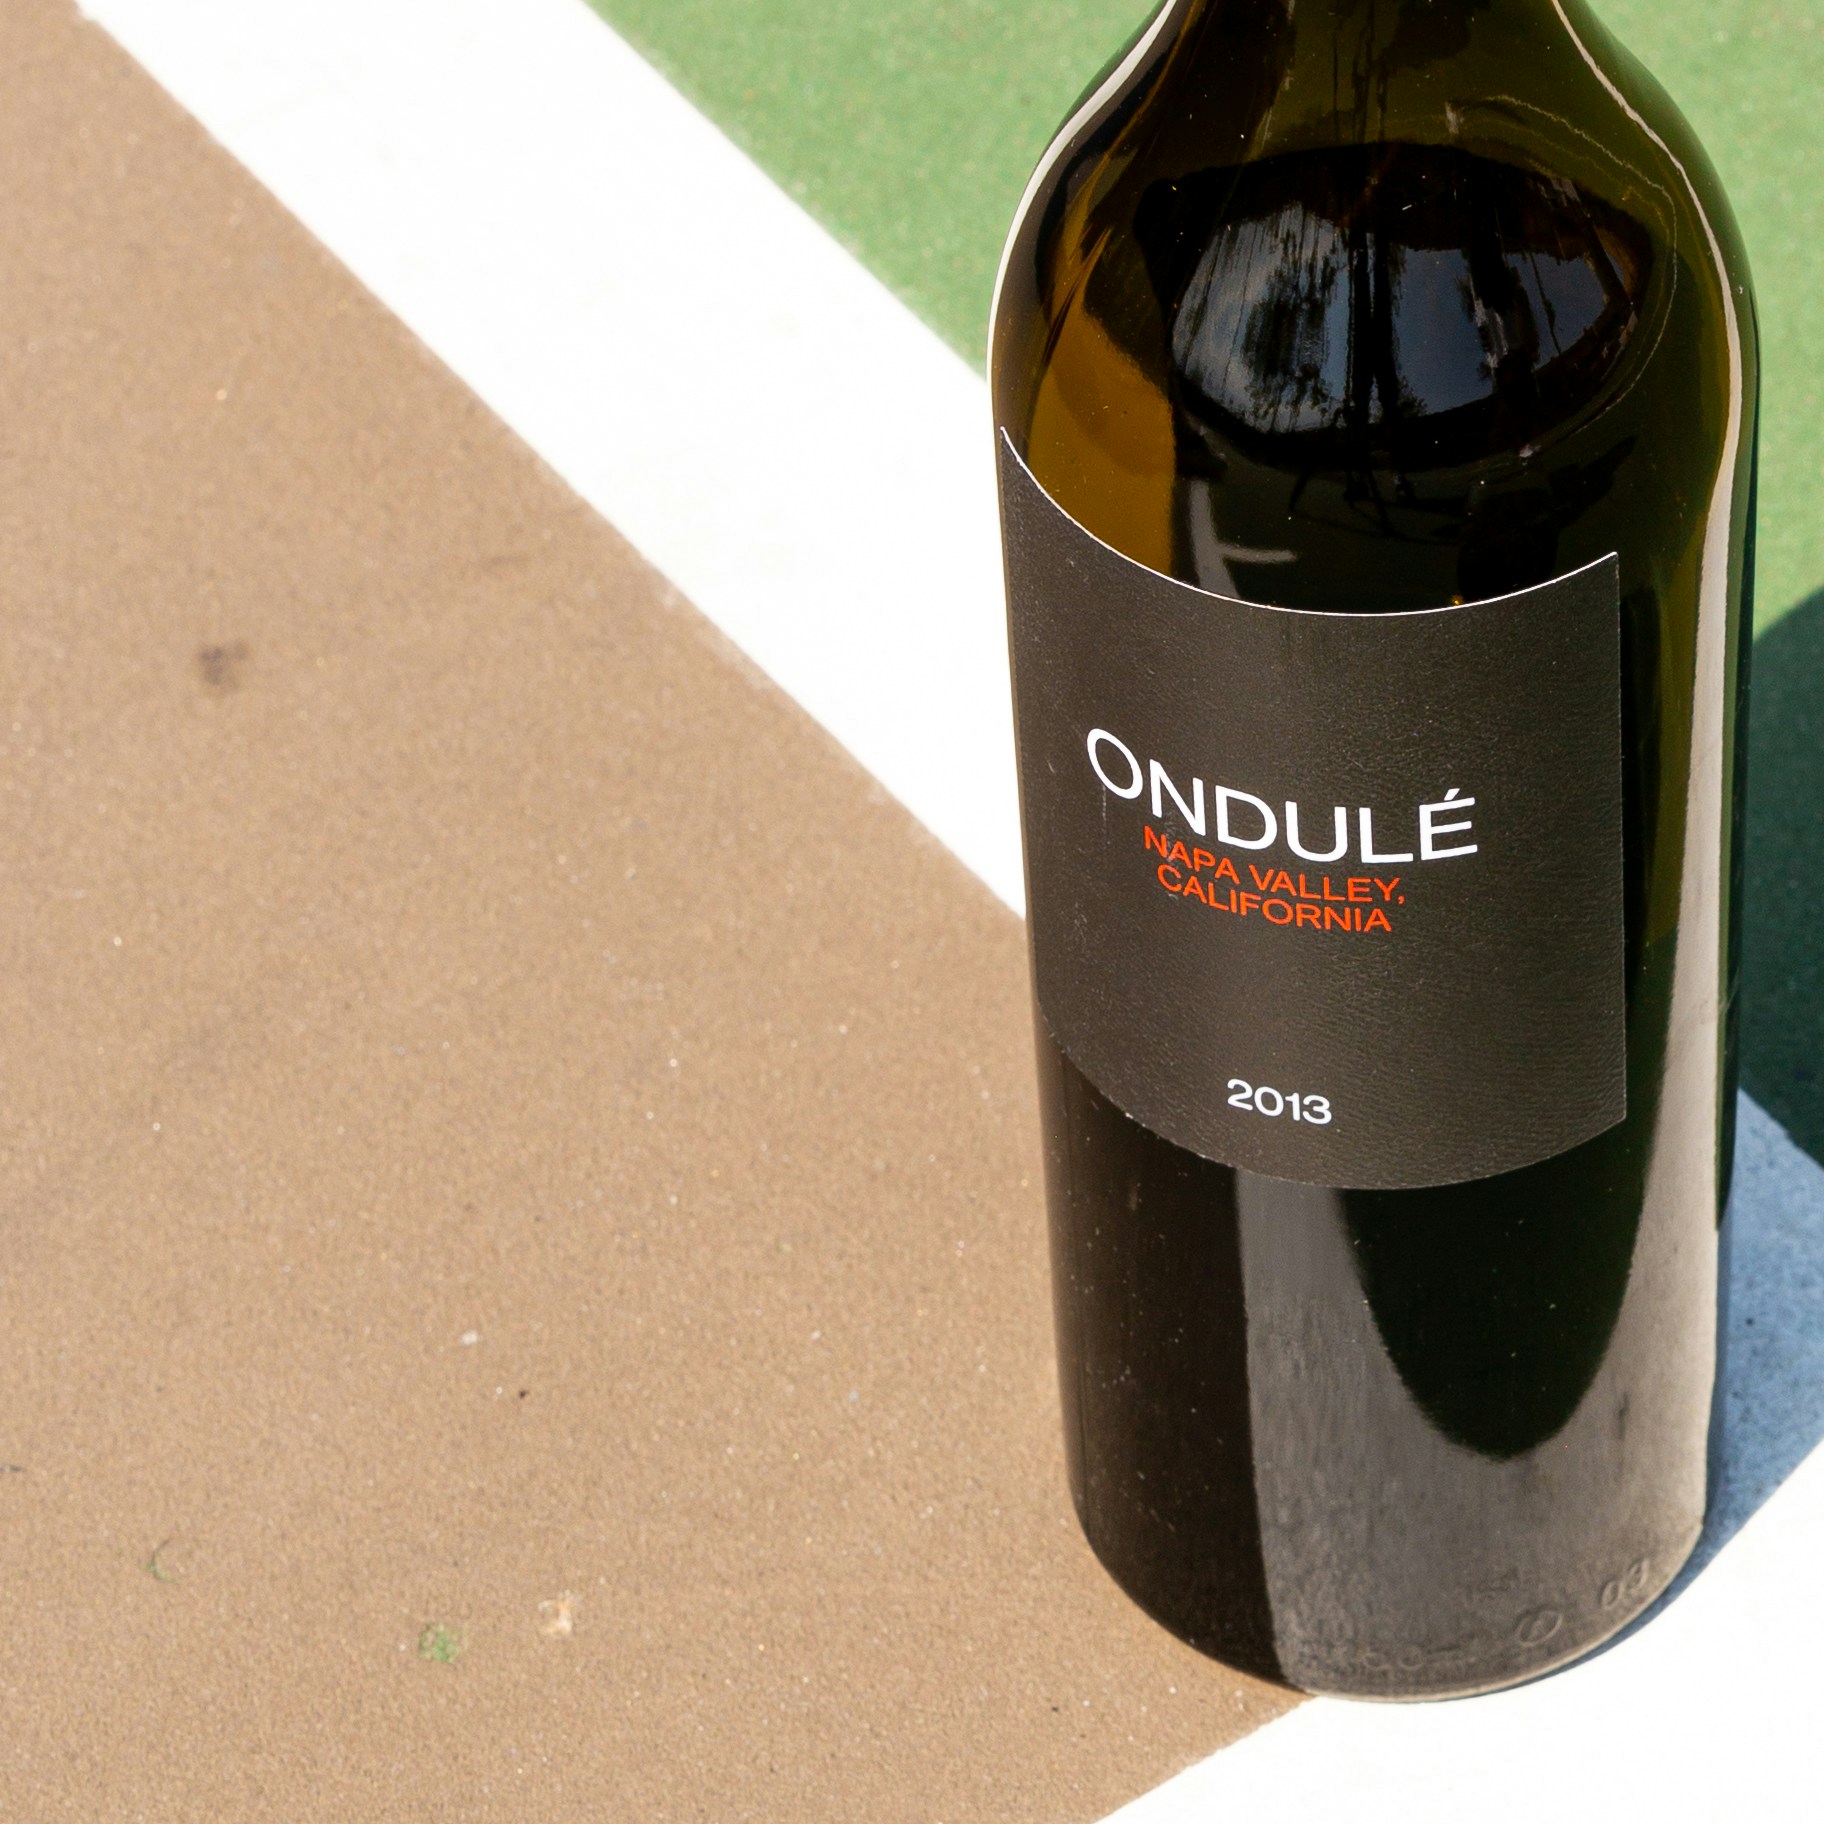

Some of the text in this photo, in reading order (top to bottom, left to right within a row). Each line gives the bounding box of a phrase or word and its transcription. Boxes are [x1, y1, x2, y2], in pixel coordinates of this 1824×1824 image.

[1086, 728, 1478, 864] ONDULÉ
[1143, 824, 1405, 905] NAPA VALLEY,
[1156, 863, 1393, 933] CALIFORNIA
[1227, 1078, 1332, 1125] 2013
